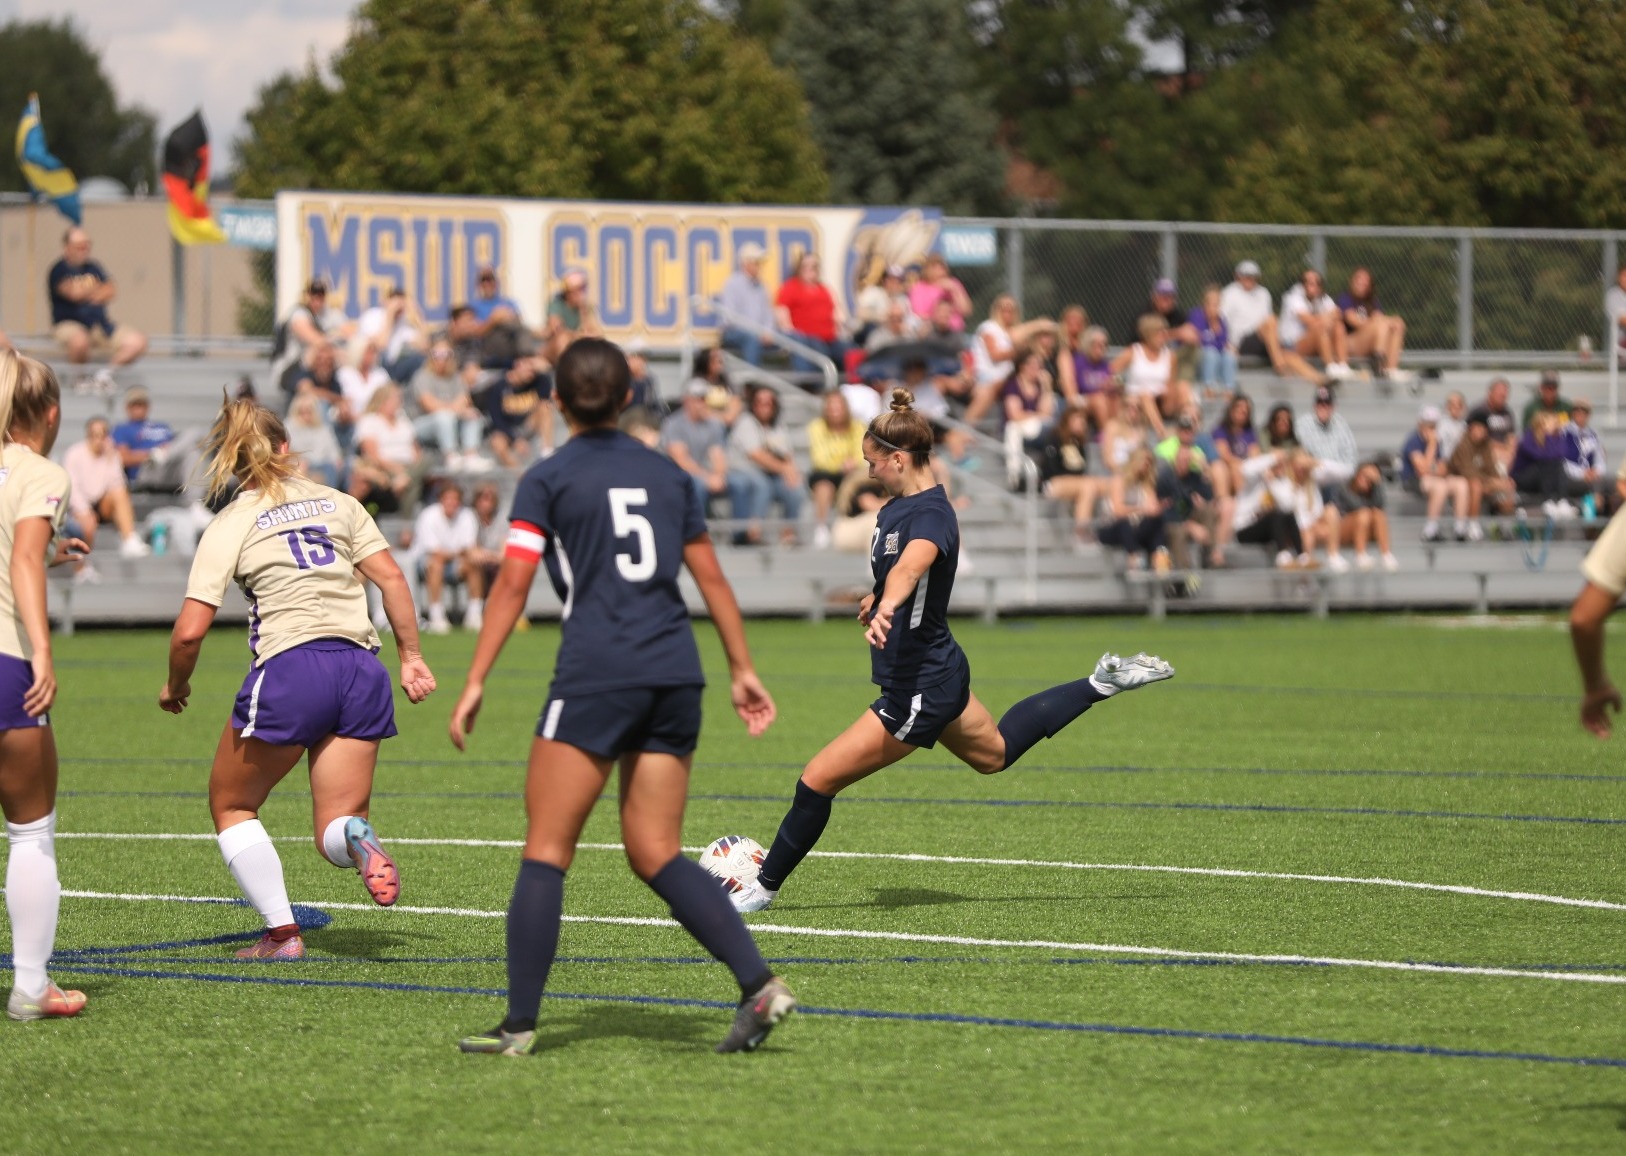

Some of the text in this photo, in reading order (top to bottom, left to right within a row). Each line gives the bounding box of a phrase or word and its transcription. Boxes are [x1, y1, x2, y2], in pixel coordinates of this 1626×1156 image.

[549, 219, 817, 329] SOCC
[256, 498, 336, 530] SAINTS
[277, 524, 336, 571] 15
[608, 487, 658, 582] 5
